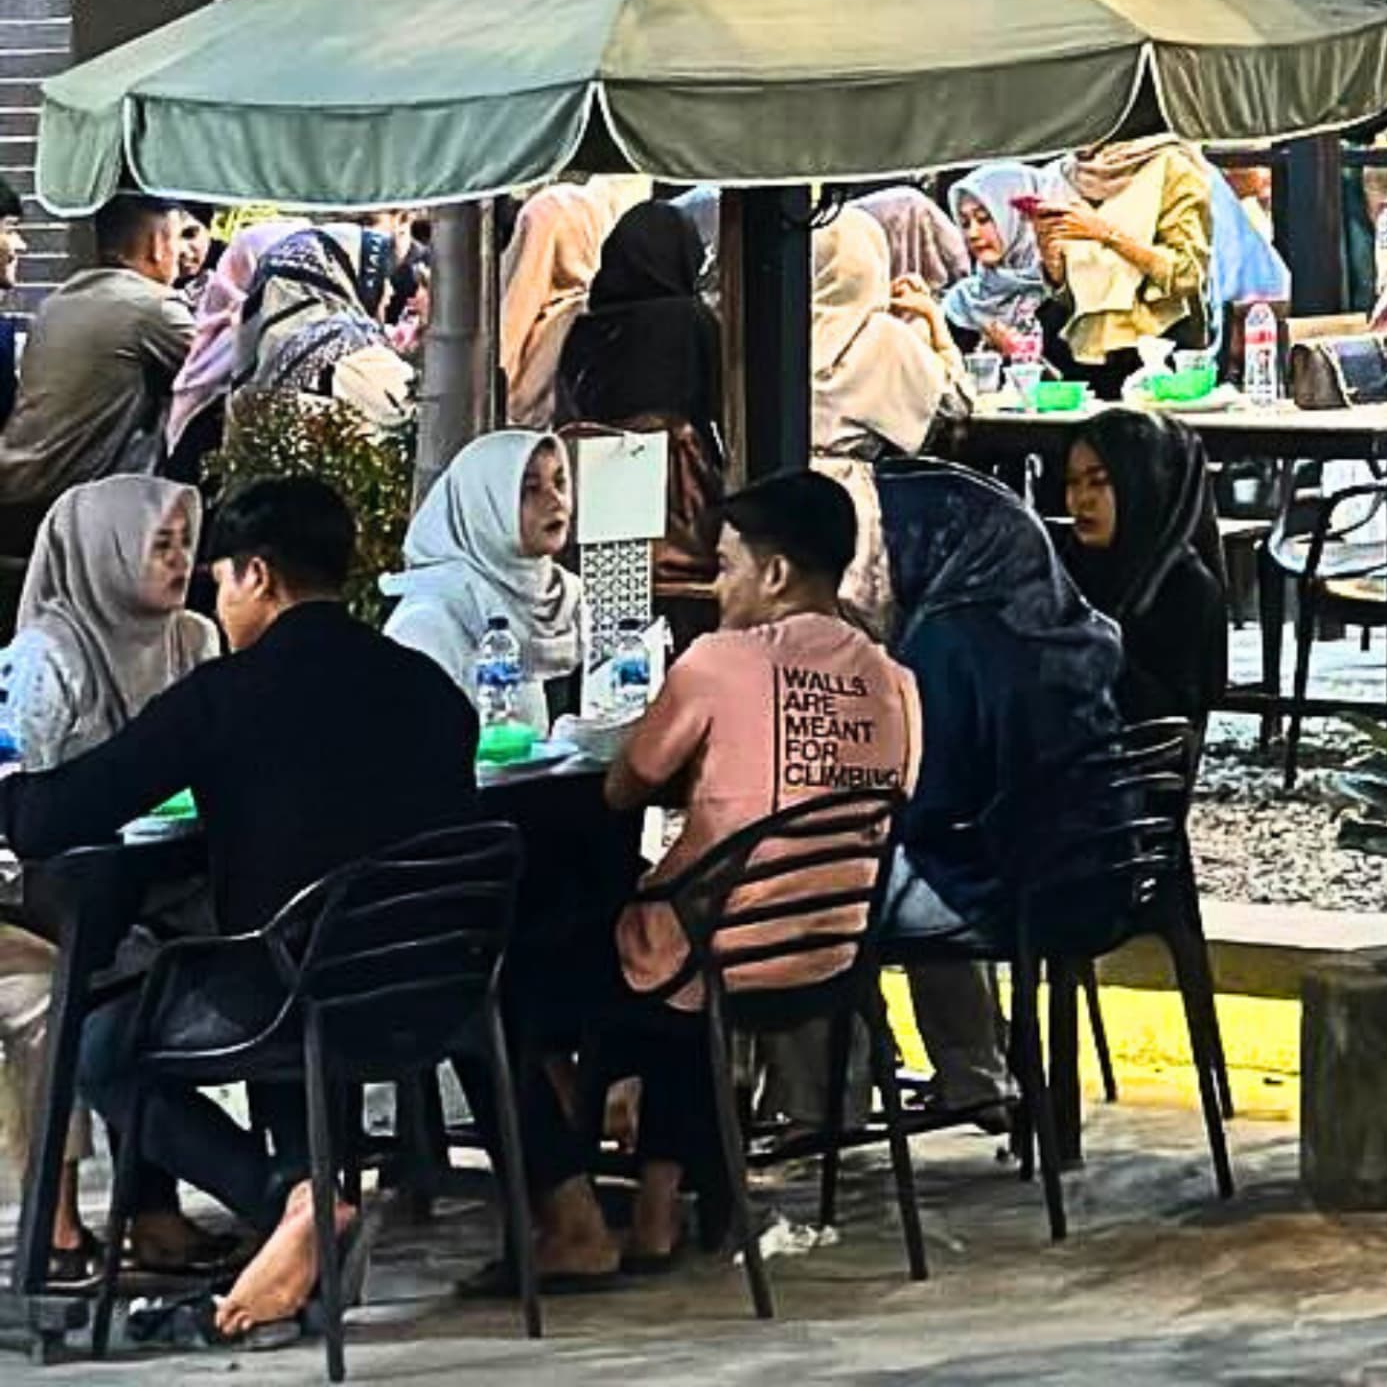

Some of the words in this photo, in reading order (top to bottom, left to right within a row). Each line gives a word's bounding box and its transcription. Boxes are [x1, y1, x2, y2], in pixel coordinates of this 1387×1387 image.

[783, 667, 867, 697] WALLS
[783, 691, 838, 715] ARE
[785, 717, 873, 743] MEANT
[785, 739, 839, 763] FOR
